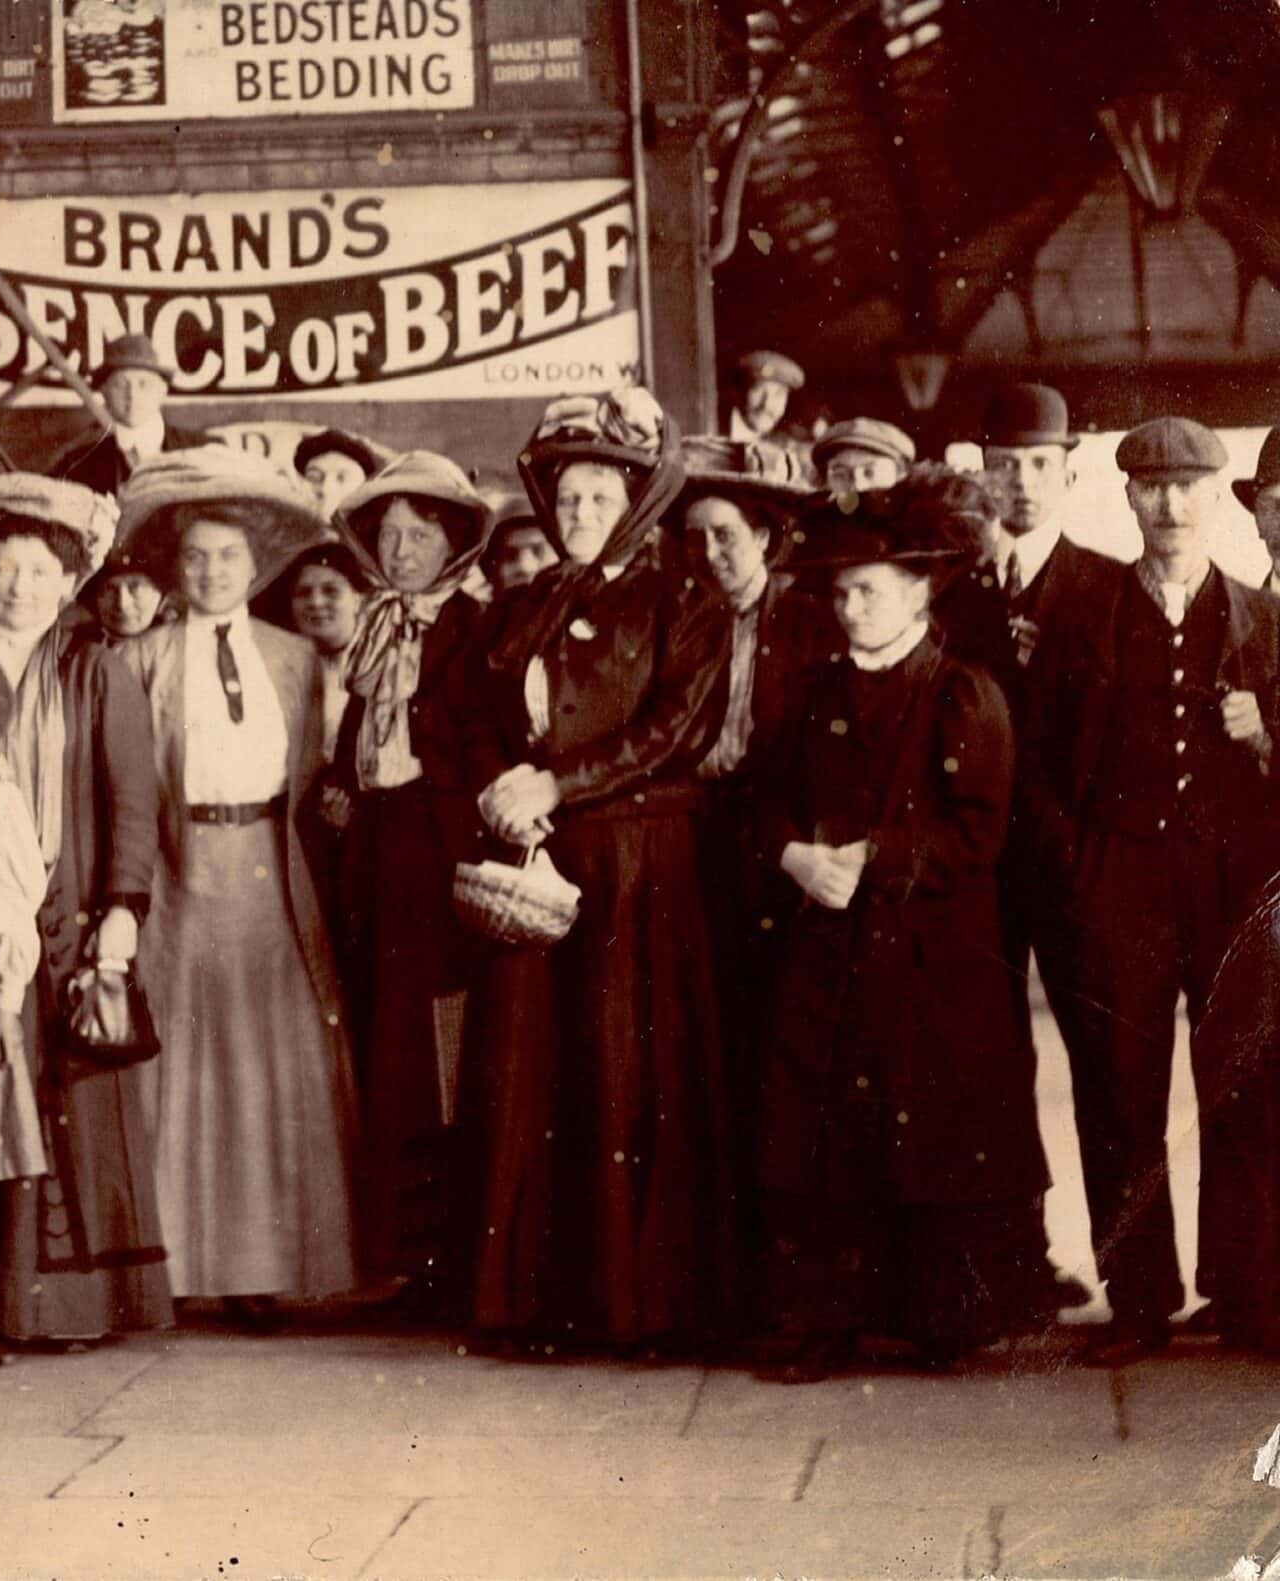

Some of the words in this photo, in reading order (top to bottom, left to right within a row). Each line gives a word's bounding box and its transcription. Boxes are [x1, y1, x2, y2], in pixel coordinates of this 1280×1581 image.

[222, 0, 459, 46] BEDSTEADS
[236, 54, 451, 102] BEDDING
[64, 193, 390, 272] BRAND'S
[289, 311, 376, 385] OF
[379, 203, 632, 374] BEEF
[483, 363, 604, 383] LONDON
